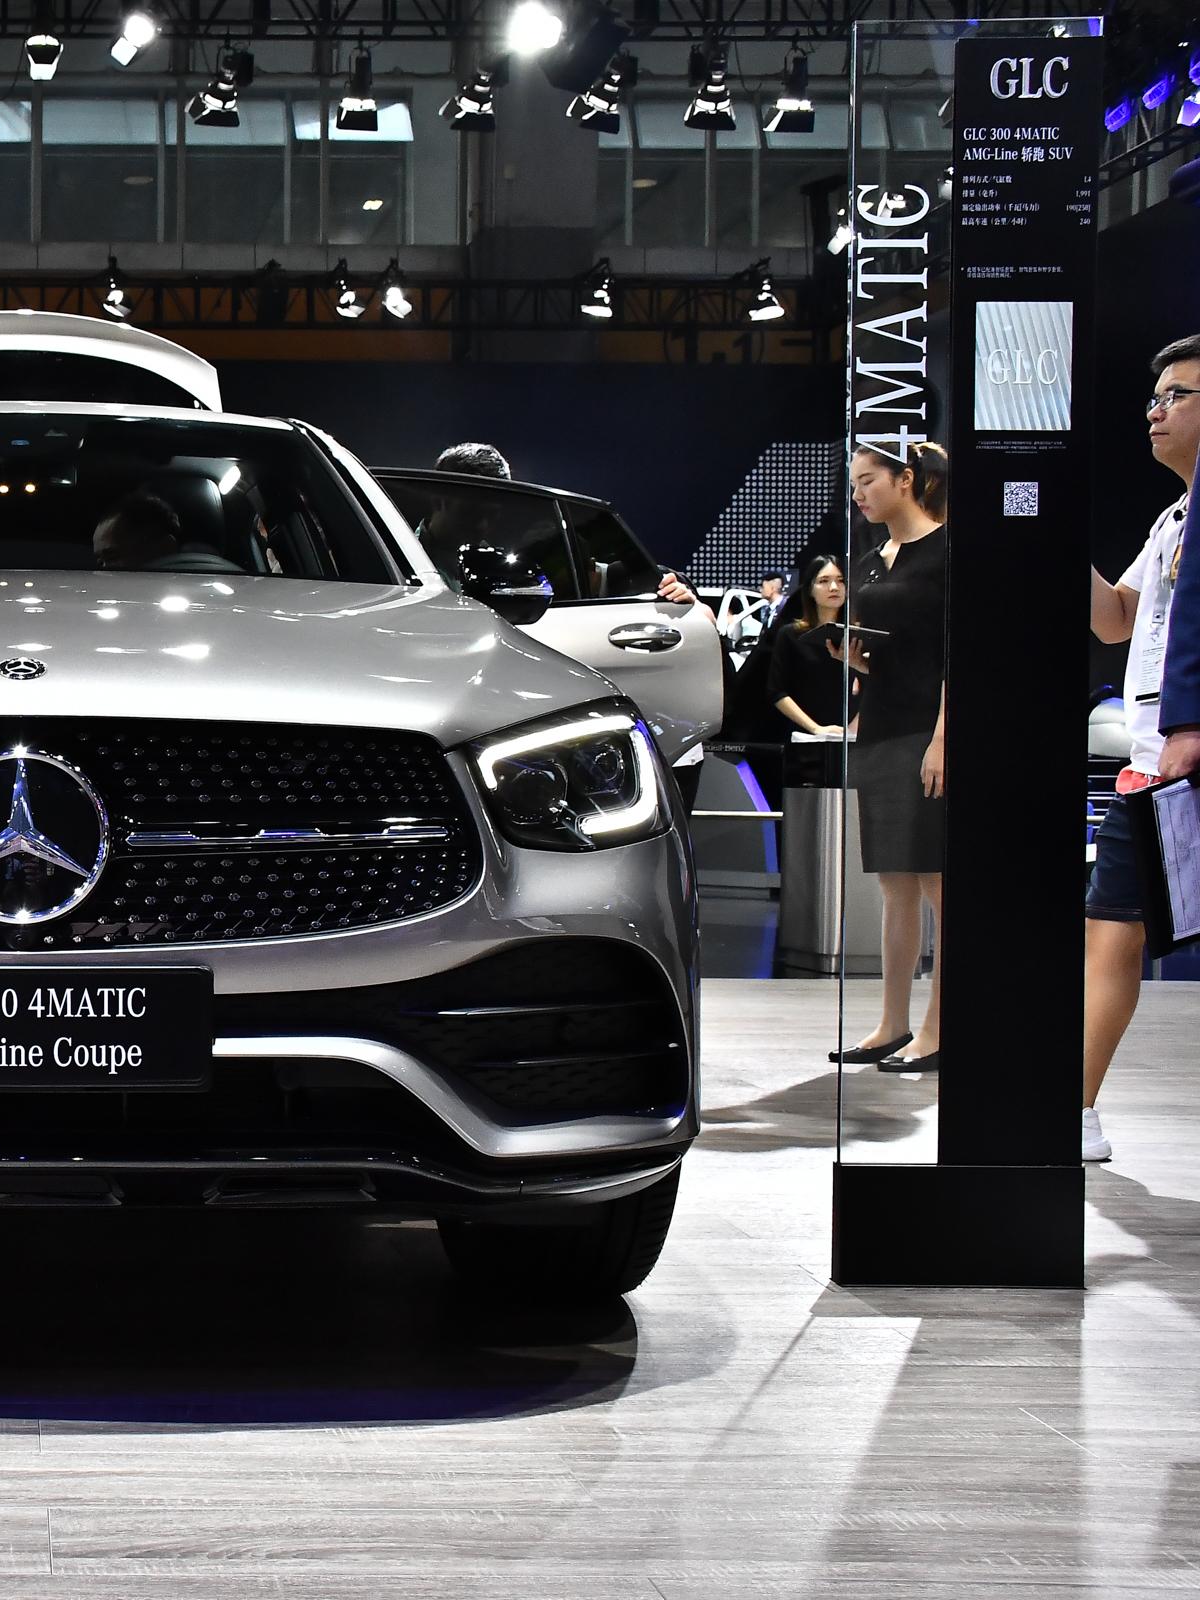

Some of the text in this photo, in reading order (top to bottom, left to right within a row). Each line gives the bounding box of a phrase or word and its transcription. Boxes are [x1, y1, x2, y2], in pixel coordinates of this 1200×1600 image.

[989, 56, 1070, 99] GLC
[963, 127, 1060, 140] GLC 300 4MATIC
[962, 146, 1074, 162] AMG-Line 轿跑 SUV
[855, 184, 930, 464] 4MATIC
[987, 349, 1058, 385] GLC
[27, 987, 147, 1018] 4MATIC
[53, 1036, 143, 1075] Coupe
